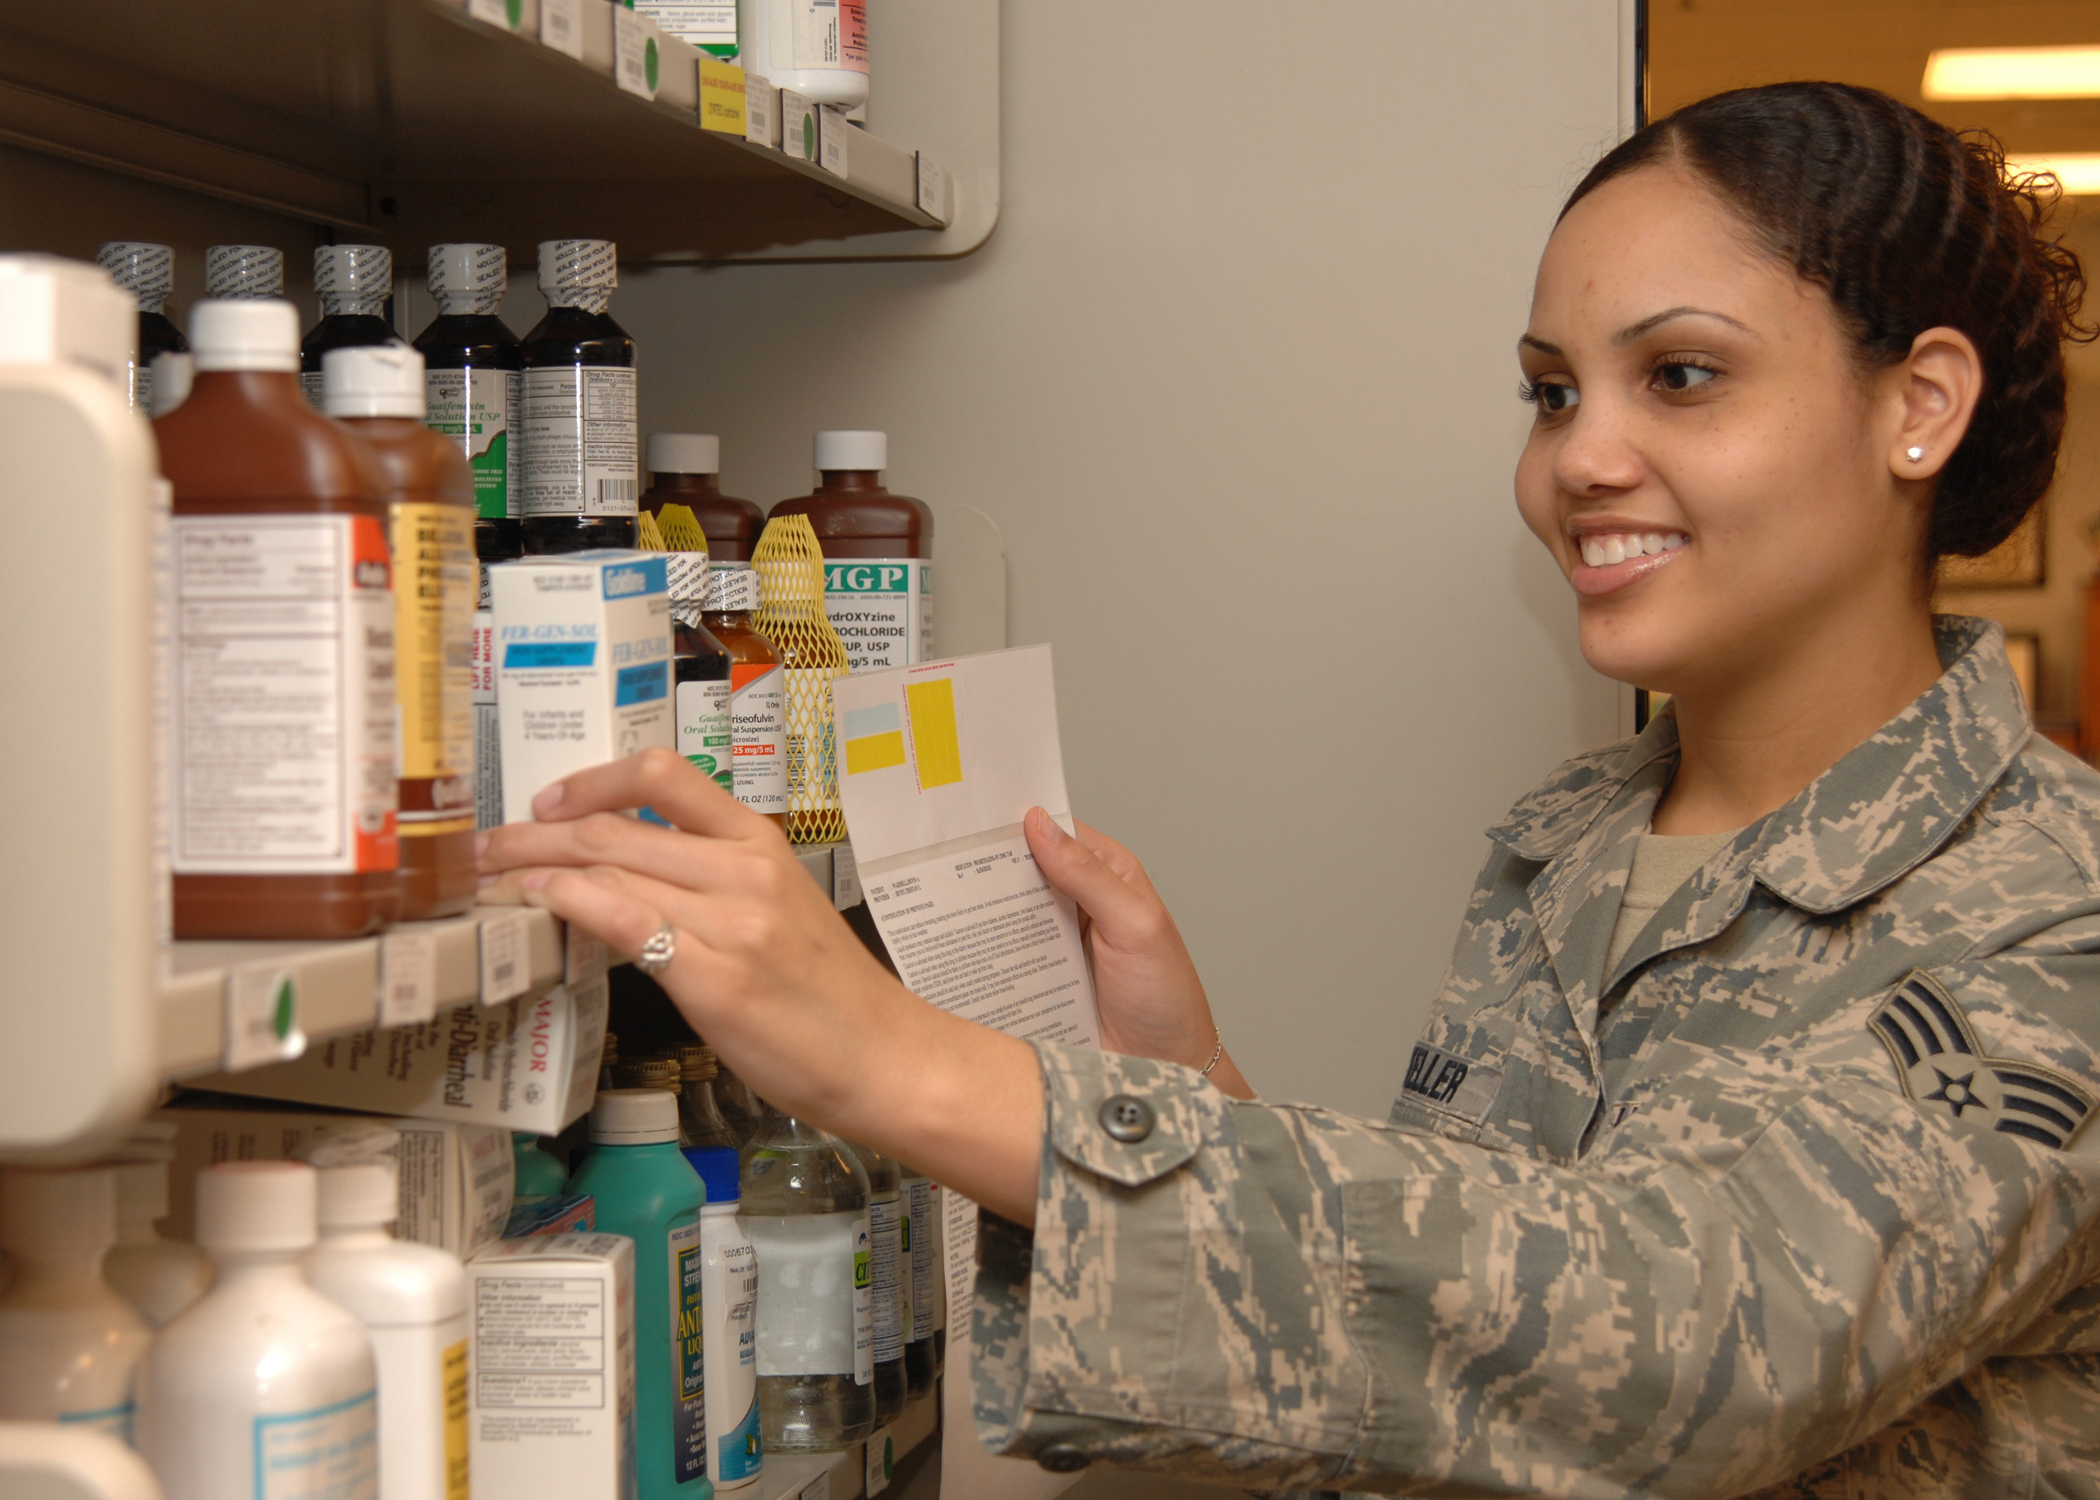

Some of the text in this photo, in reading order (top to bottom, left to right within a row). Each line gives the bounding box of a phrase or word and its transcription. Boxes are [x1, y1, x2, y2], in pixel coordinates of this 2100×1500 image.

[479, 413, 501, 421] USP
[826, 612, 896, 624] ydrOXYzine
[501, 624, 599, 641] FER-GEN-SOL
[835, 627, 906, 637] ROCHLORIDE
[846, 642, 890, 652] UP, USP
[483, 627, 492, 691] FOR MORE
[873, 657, 891, 666] mL
[732, 713, 775, 723] riseofulvin
[683, 725, 708, 735] Oral
[740, 725, 774, 736] Suspension
[733, 736, 760, 744] icrosize)
[733, 745, 774, 755] 25 mg/5 mL
[529, 996, 554, 1073] MAJOR
[444, 1004, 478, 1108] nti-Diarrheal
[1403, 1047, 1468, 1103] ELLER
[684, 1271, 702, 1287] STRE
[677, 1306, 703, 1340] ANT
[688, 1337, 703, 1355] LIQ
